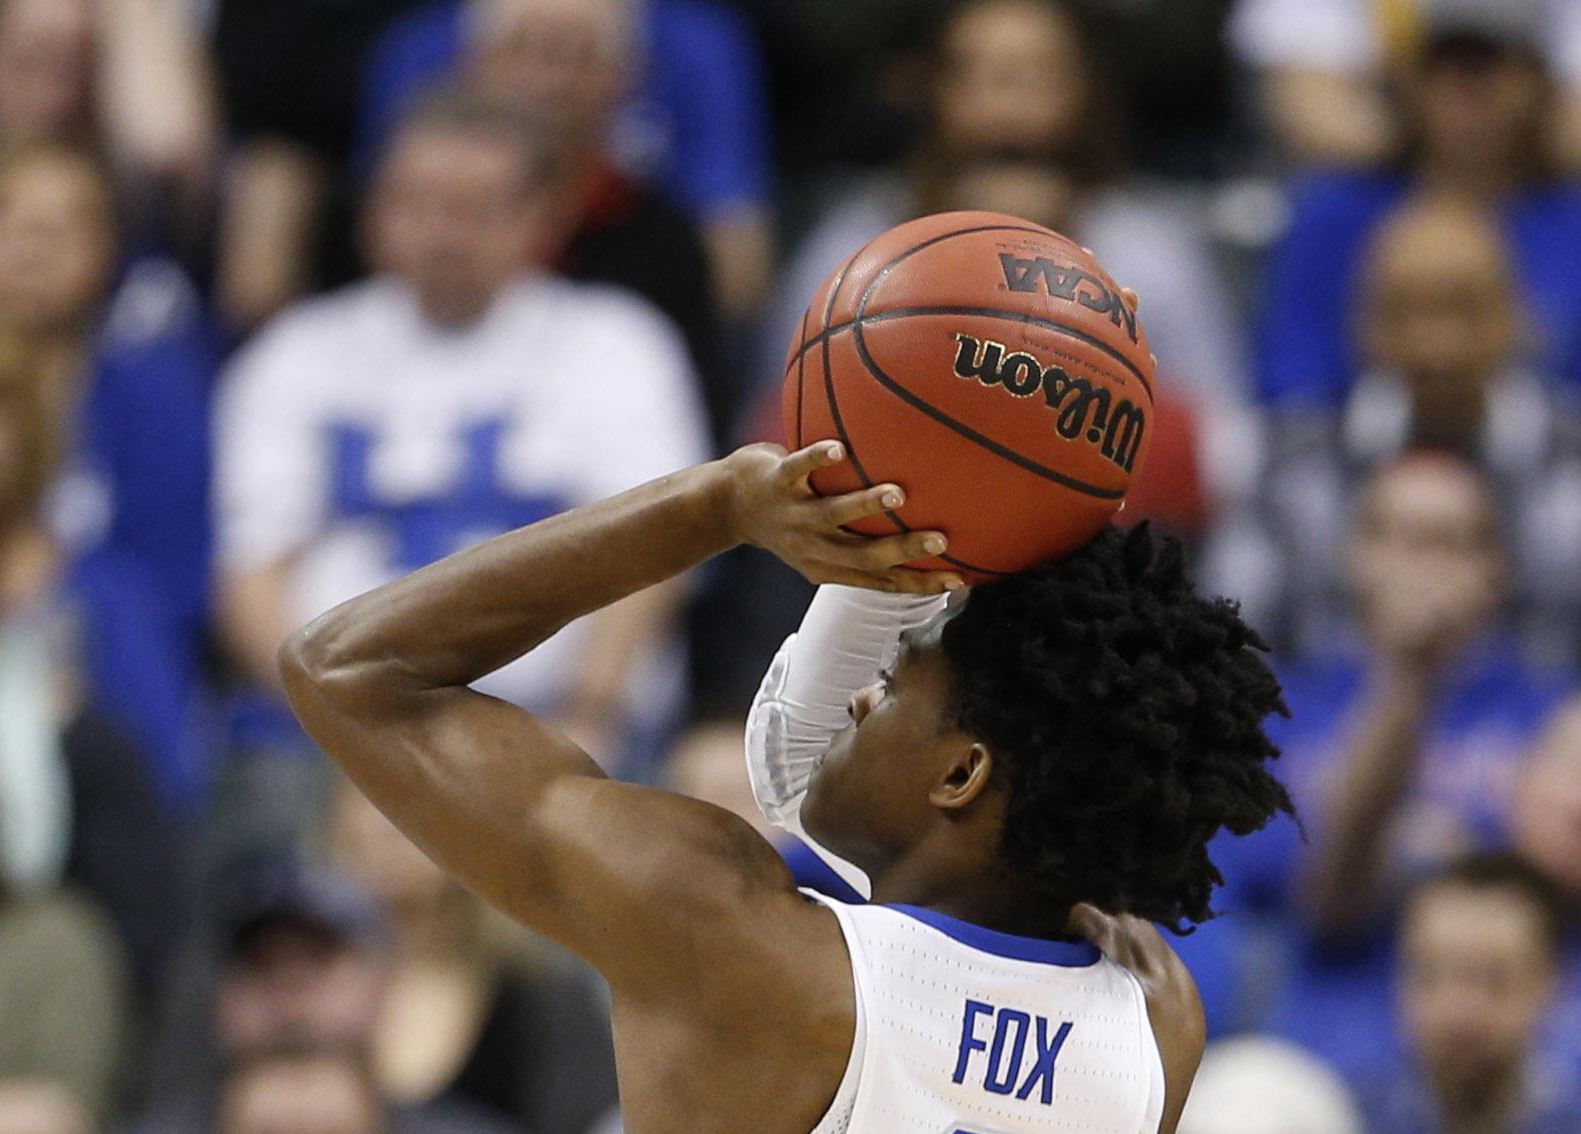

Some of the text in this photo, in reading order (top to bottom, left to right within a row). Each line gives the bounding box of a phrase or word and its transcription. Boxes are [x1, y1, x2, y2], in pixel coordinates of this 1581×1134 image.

[998, 252, 1139, 345] NCAA
[952, 332, 1146, 475] Wilson
[952, 999, 1074, 1106] FOX
